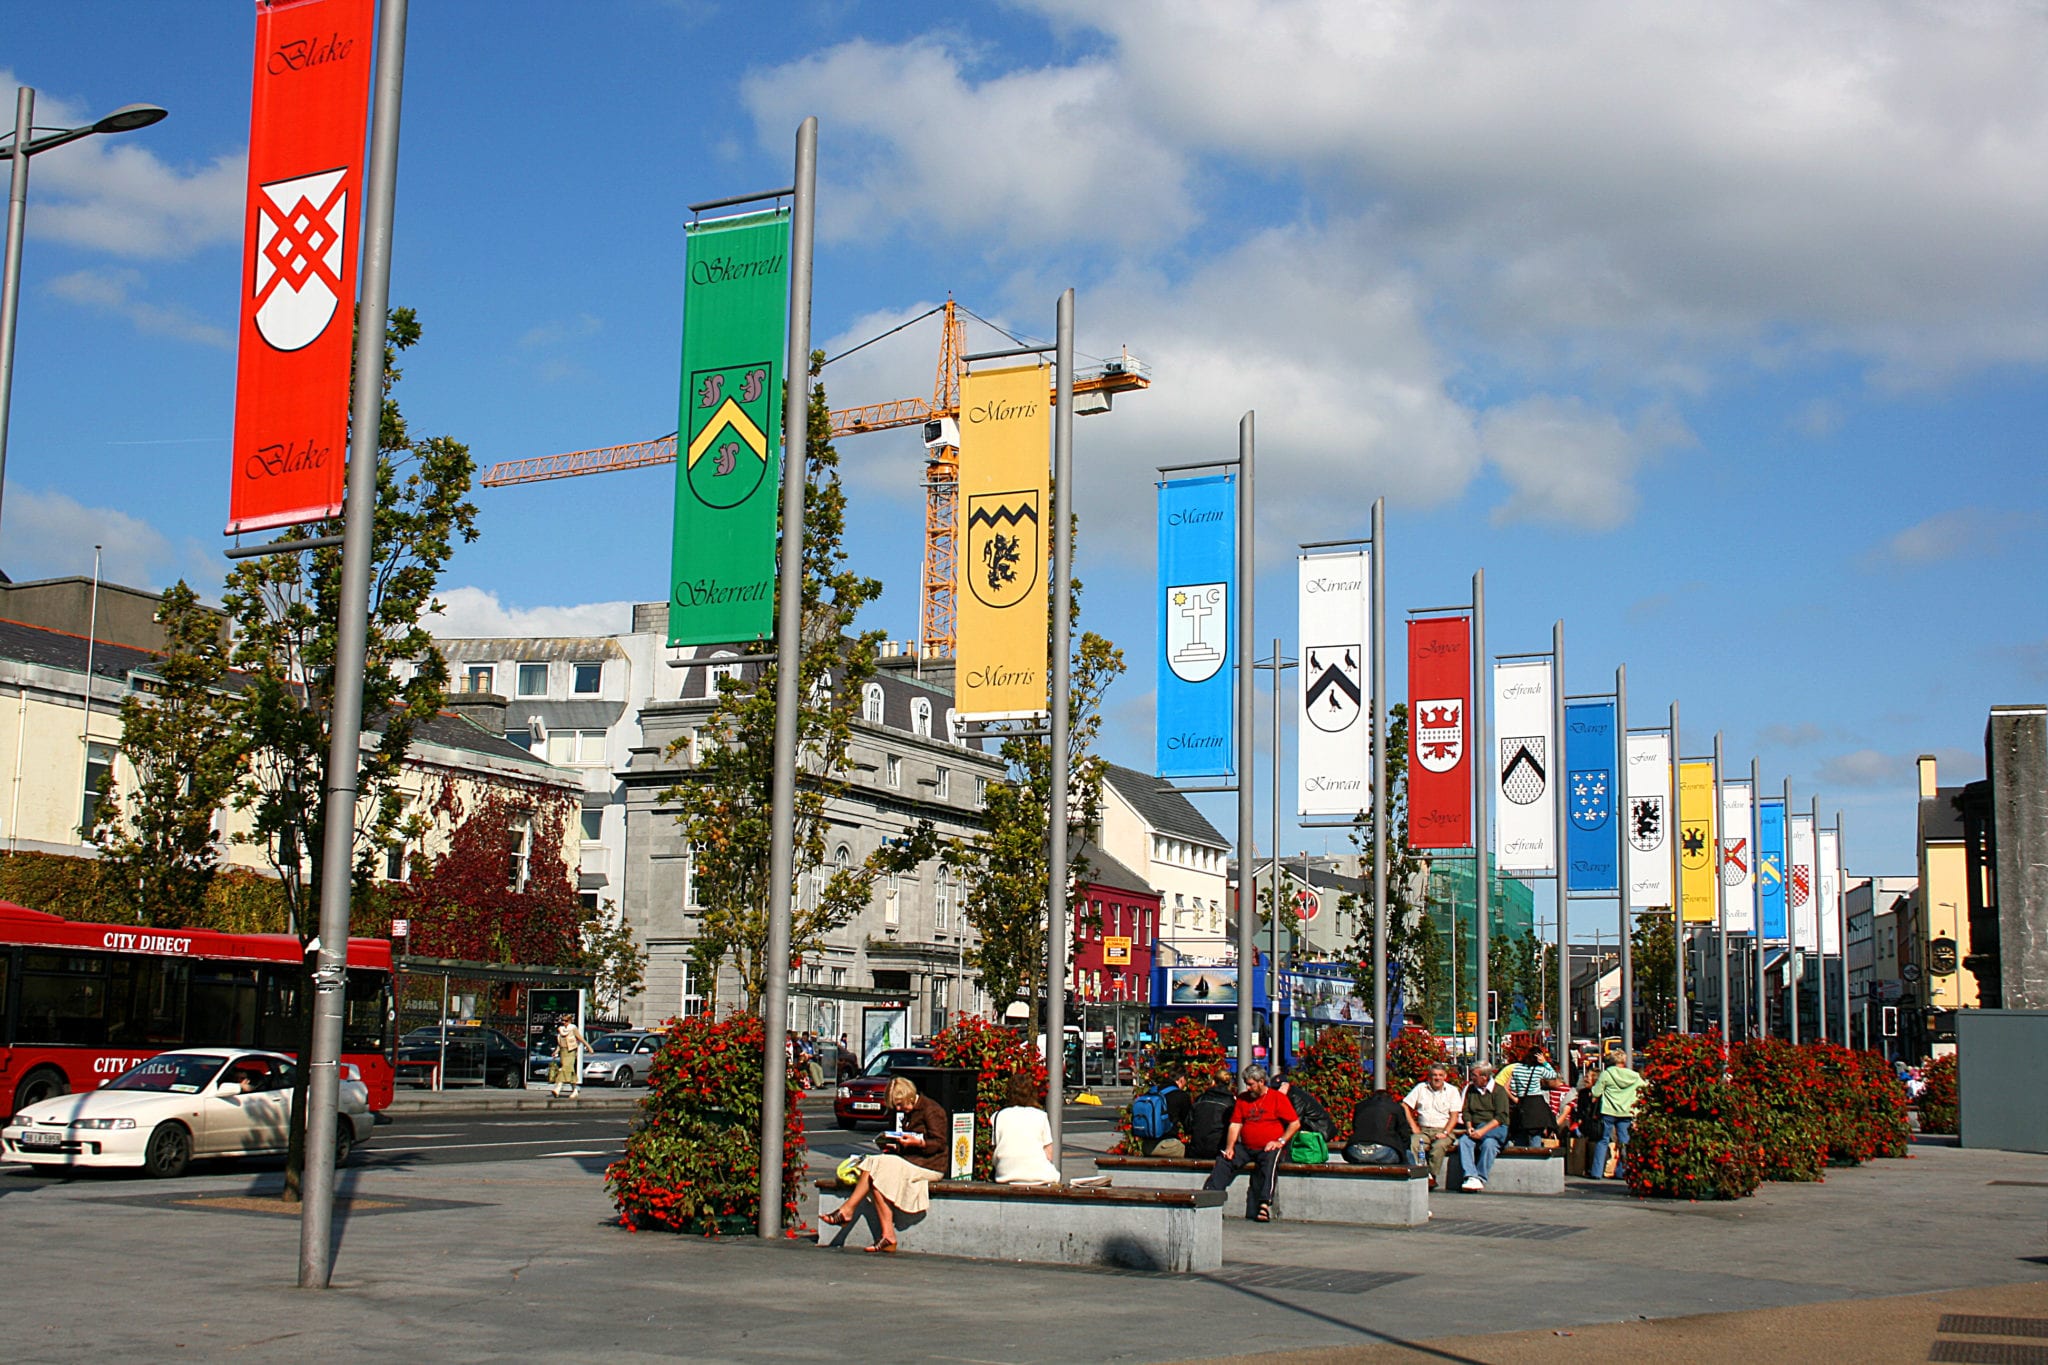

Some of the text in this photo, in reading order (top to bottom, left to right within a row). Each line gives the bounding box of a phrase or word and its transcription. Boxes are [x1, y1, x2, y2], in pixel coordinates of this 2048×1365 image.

[267, 32, 353, 76] Blake
[691, 254, 783, 286] Skerrett
[969, 400, 1038, 424] Morris
[245, 439, 330, 480] Blake
[1168, 508, 1224, 527] Martin
[675, 579, 768, 608] Skerrett
[1306, 578, 1361, 594] Kirwan
[1417, 640, 1461, 659] Joyce
[966, 665, 1036, 689] Morris
[1503, 682, 1542, 700] Ffrench
[1569, 722, 1608, 737] Darcy
[1167, 732, 1223, 750] Martin
[1629, 752, 1658, 766] Font
[1304, 776, 1360, 792] Kirwan
[1417, 809, 1462, 829] Joyce
[1504, 838, 1544, 855] Ffrench
[1571, 860, 1610, 876] Darcy
[1632, 879, 1661, 893] Font
[103, 931, 192, 953] CITY DIRECT
[93, 1057, 128, 1074] CITY
